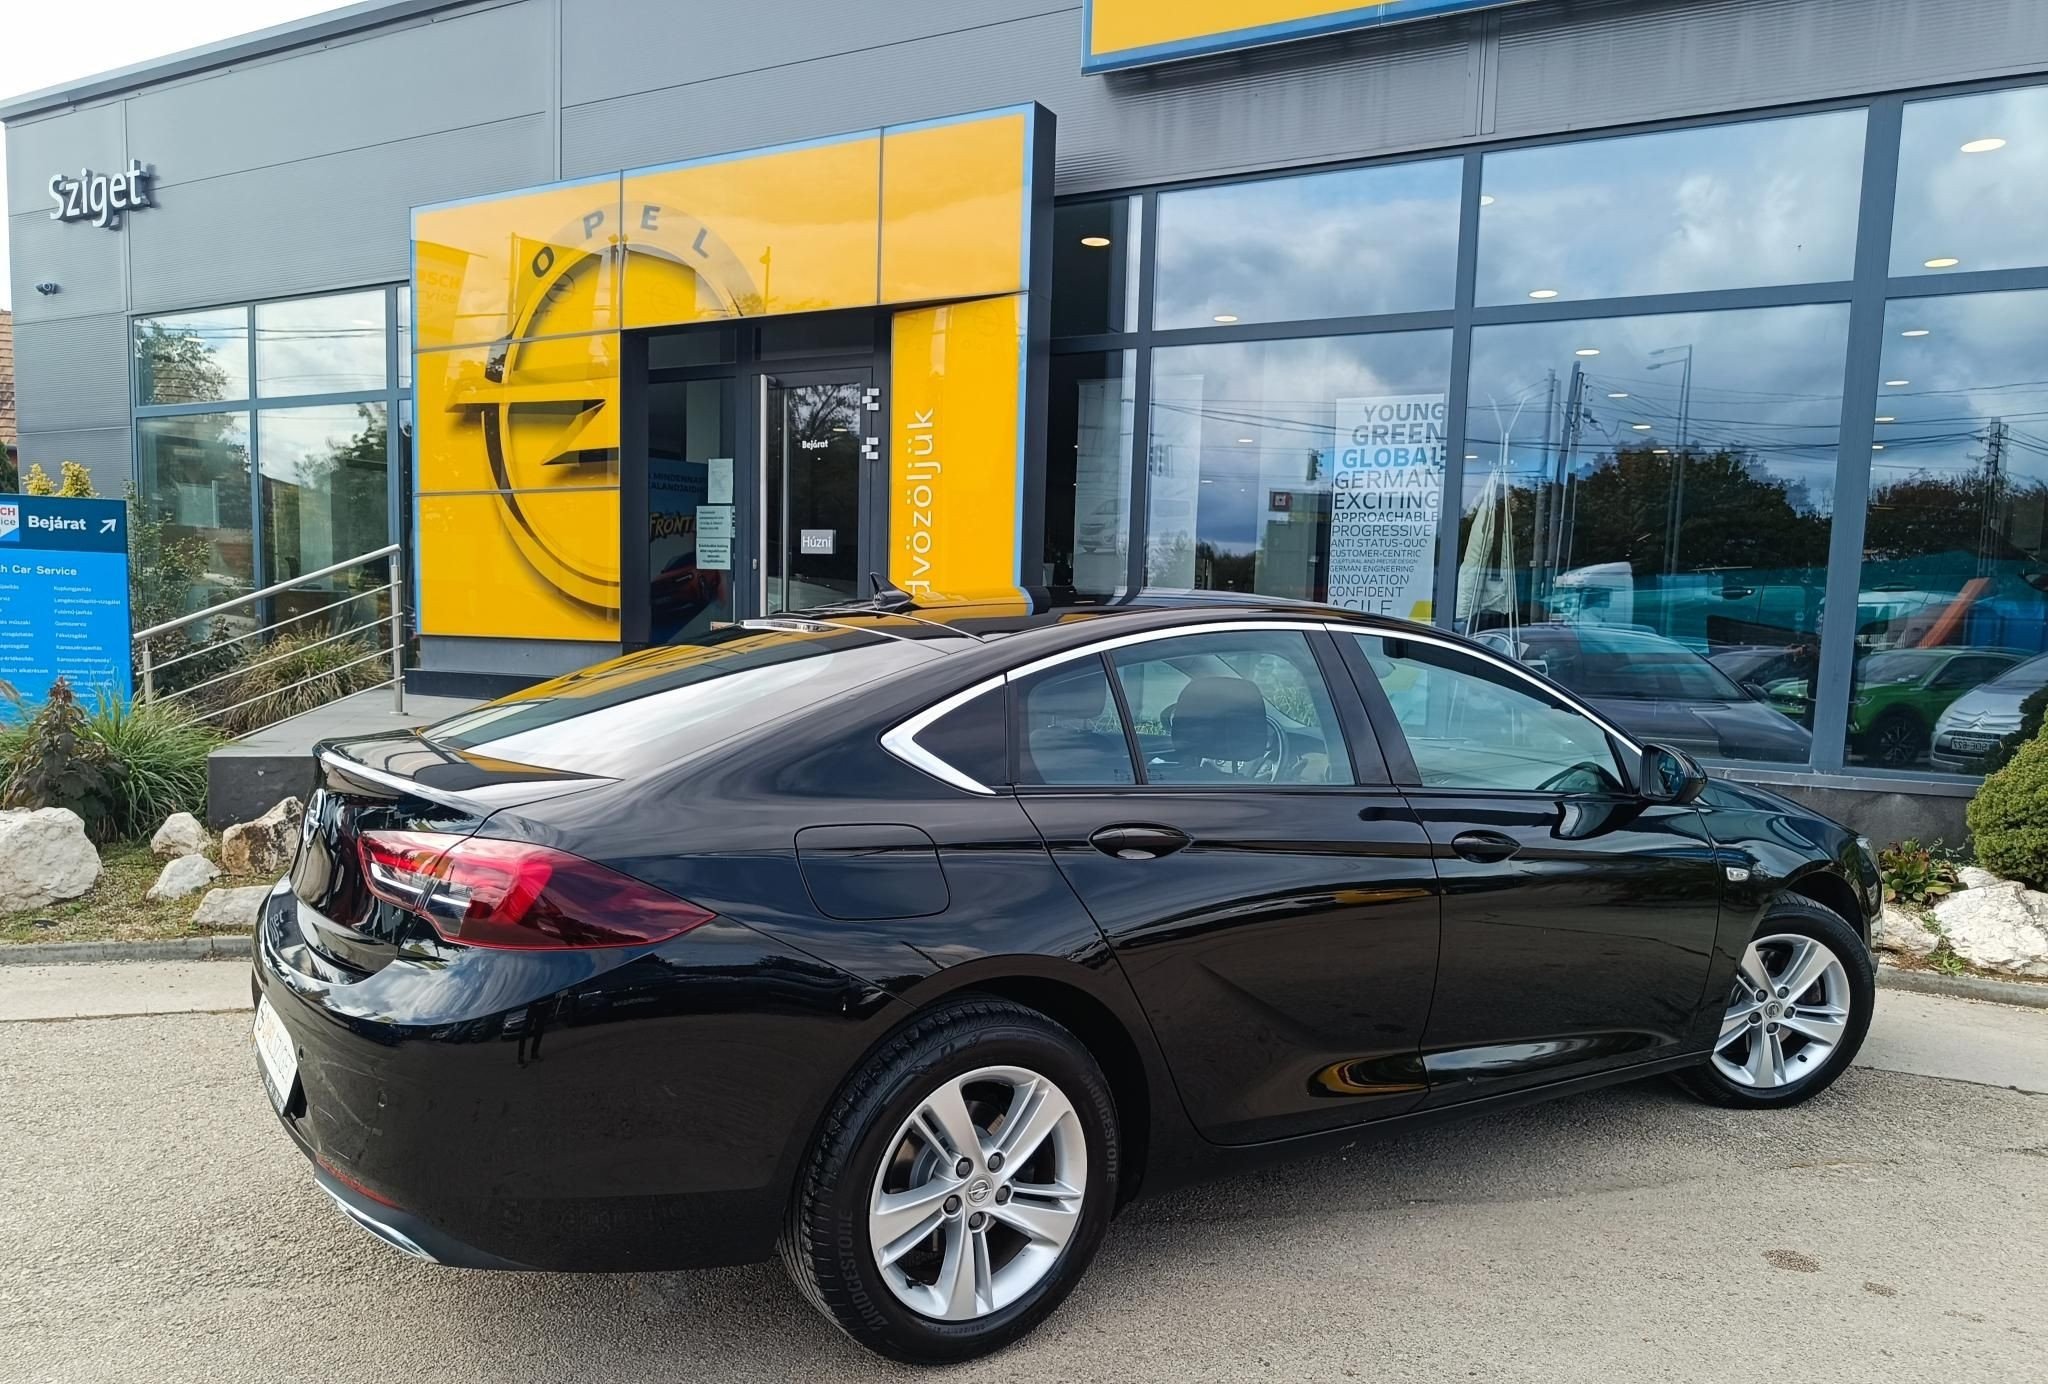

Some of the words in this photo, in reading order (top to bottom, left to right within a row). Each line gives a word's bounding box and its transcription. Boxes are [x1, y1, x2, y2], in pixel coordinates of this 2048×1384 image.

[48, 158, 141, 228] Sziget
[531, 204, 711, 279] OPEL
[1364, 402, 1444, 422] YOUNG
[1352, 422, 1441, 446] GREEN
[801, 439, 829, 451] Bejárat
[1342, 446, 1441, 468] GLOBAL
[1334, 468, 1441, 489] GERMAN
[1334, 490, 1439, 510] EXCITING
[1332, 511, 1440, 522] APPROACHABLE
[28, 515, 87, 532] Bejárat
[1331, 524, 1432, 537] PROGRESSIVE
[802, 535, 832, 548] Húzni
[1331, 539, 1354, 548] ANTI
[1357, 538, 1427, 548] STATUS-QUO
[1330, 549, 1421, 558] CUSTOMER-CENTRIC
[12, 564, 32, 575] Car
[36, 565, 78, 576] Service
[1330, 565, 1361, 573] GERMAN
[1363, 565, 1415, 573] ENGINEERING
[1329, 574, 1410, 585] INNOVATION
[1329, 586, 1405, 597] CONFIDENT
